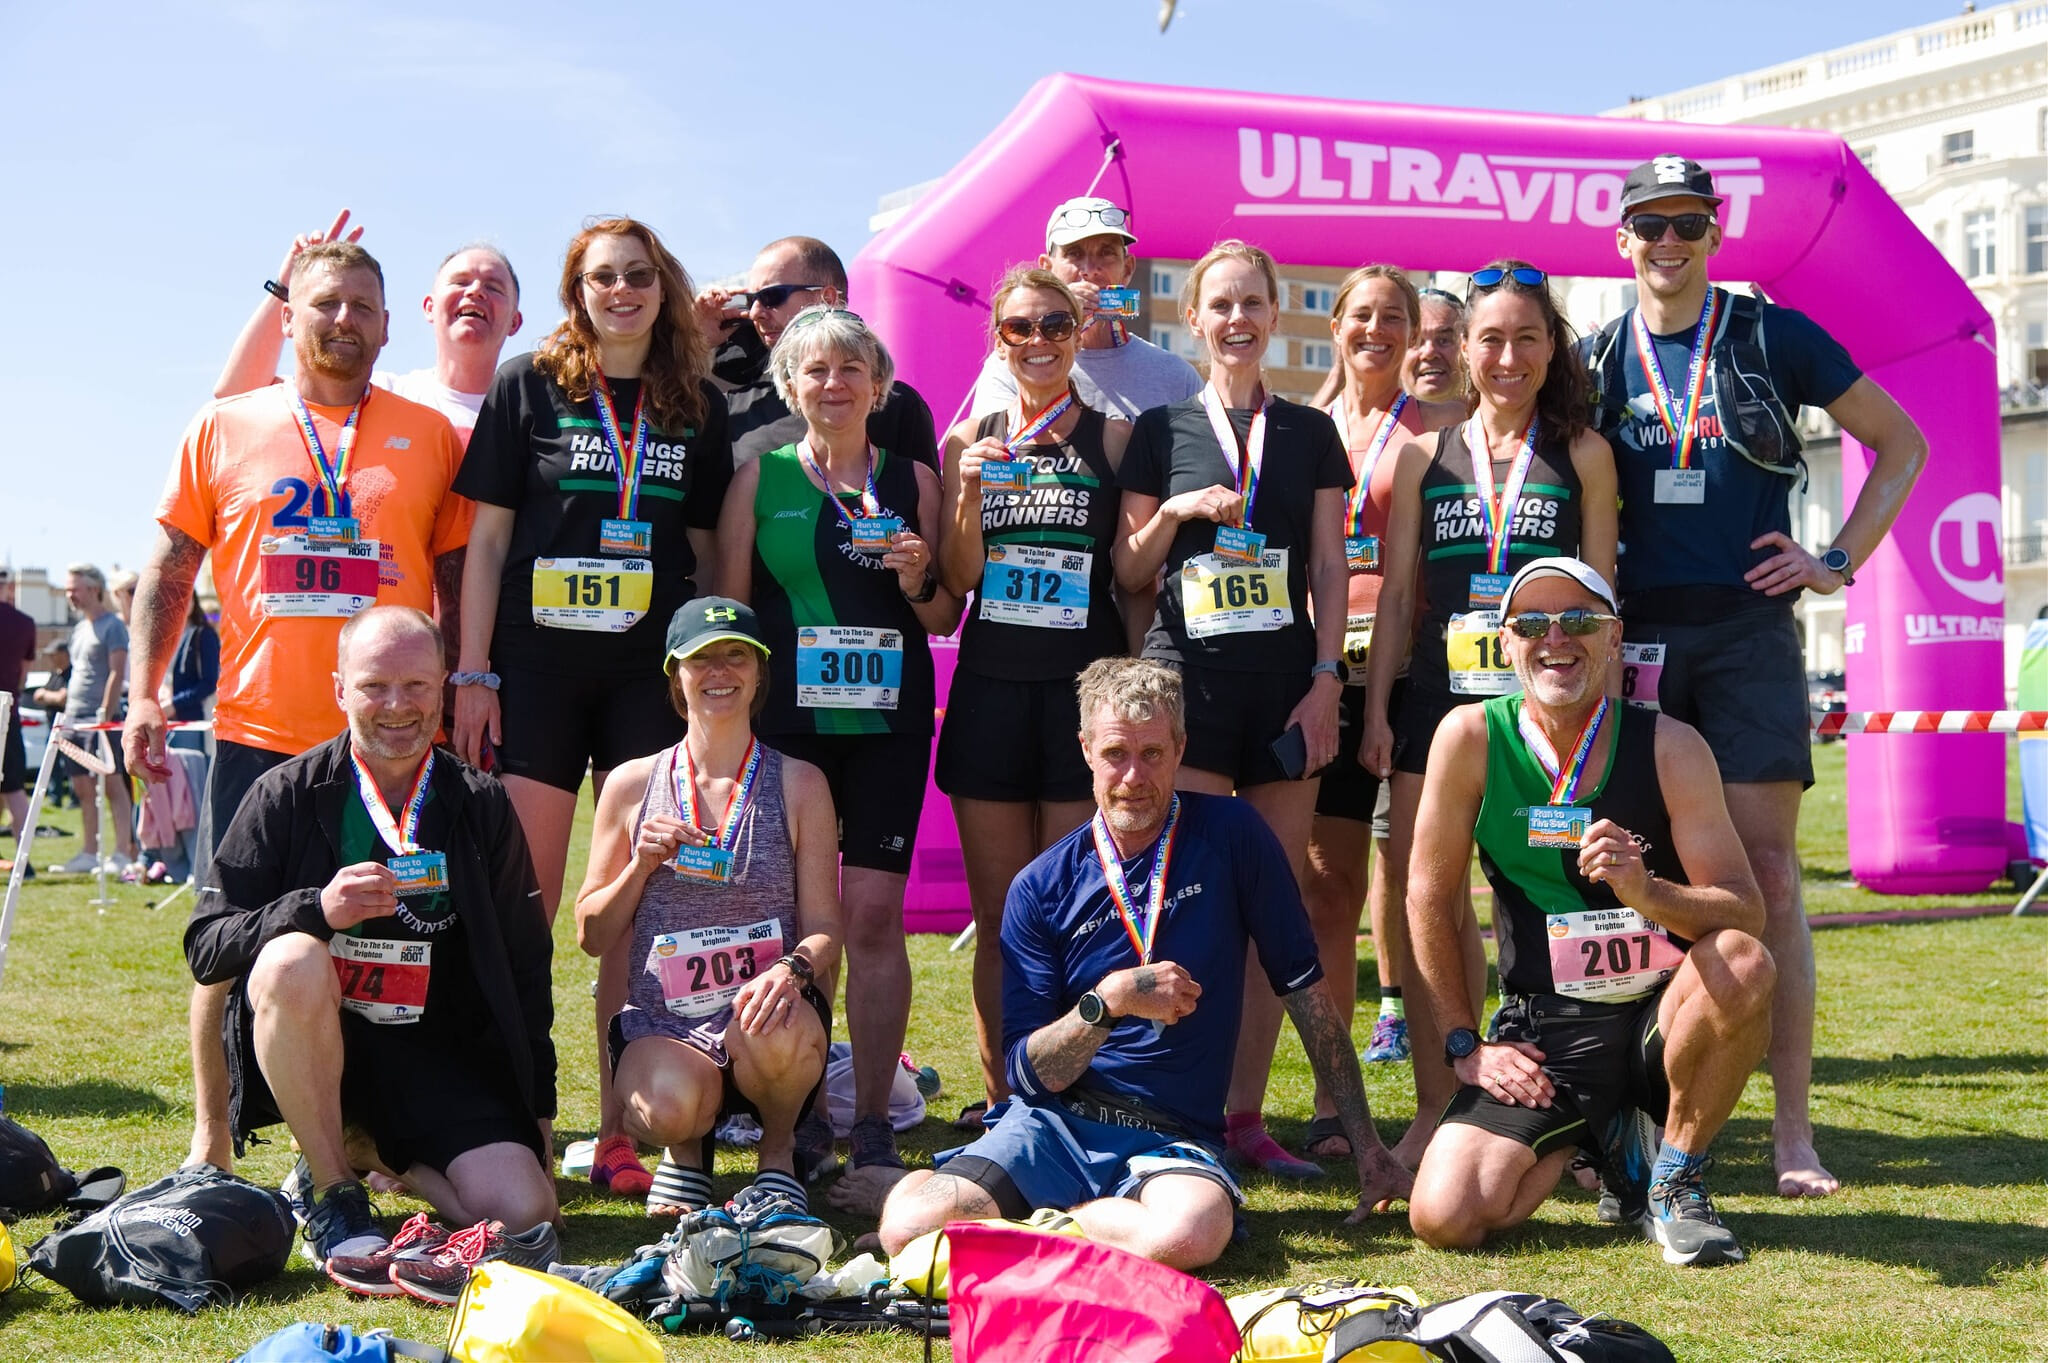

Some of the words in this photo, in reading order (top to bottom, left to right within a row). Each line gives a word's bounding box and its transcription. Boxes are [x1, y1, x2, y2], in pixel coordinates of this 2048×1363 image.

[1238, 127, 1764, 239] ULTRAVIOT
[601, 407, 619, 448] Brighton
[570, 434, 687, 461] HASNGS
[632, 433, 645, 452] Run
[1701, 436, 1727, 450] 201
[570, 453, 685, 481] RUNERS
[981, 488, 1090, 511] HASTINGS
[982, 506, 1090, 531] RUNNERS
[1222, 529, 1236, 538] Run
[1237, 532, 1245, 540] to
[1435, 518, 1556, 542] RUNERS
[1218, 537, 1232, 545] The
[1232, 539, 1246, 547] Sea
[577, 560, 605, 569] Brighton
[838, 542, 885, 570] RUNN
[1061, 560, 1084, 571] ROOT
[295, 558, 341, 590] 96
[564, 574, 620, 606] 151
[1006, 568, 1062, 603] 312
[1208, 574, 1269, 609] 165
[879, 639, 897, 648] ROOT
[1475, 636, 1513, 668] 18
[821, 651, 883, 684] 300
[1531, 818, 1549, 828] The
[1550, 818, 1568, 828] Sea
[1533, 808, 1552, 818] Run
[1554, 809, 1565, 818] to
[684, 847, 700, 856] Run
[702, 850, 710, 858] to
[1156, 837, 1171, 859] Sea
[393, 860, 410, 868] Run
[408, 868, 426, 876] Sea
[680, 855, 696, 864] The
[696, 857, 713, 867] Sea
[1150, 861, 1166, 913] Brighton
[1122, 898, 1137, 921] Run
[1583, 913, 1597, 922] Run
[1607, 912, 1620, 920] The
[748, 930, 772, 940] ROOT
[1595, 923, 1626, 932] Brighton
[702, 936, 731, 946] Brighton
[354, 950, 382, 958] Brighton
[400, 952, 423, 962] ROOT
[1581, 935, 1651, 977] 207
[686, 947, 756, 992] 203
[343, 964, 385, 999] 74
